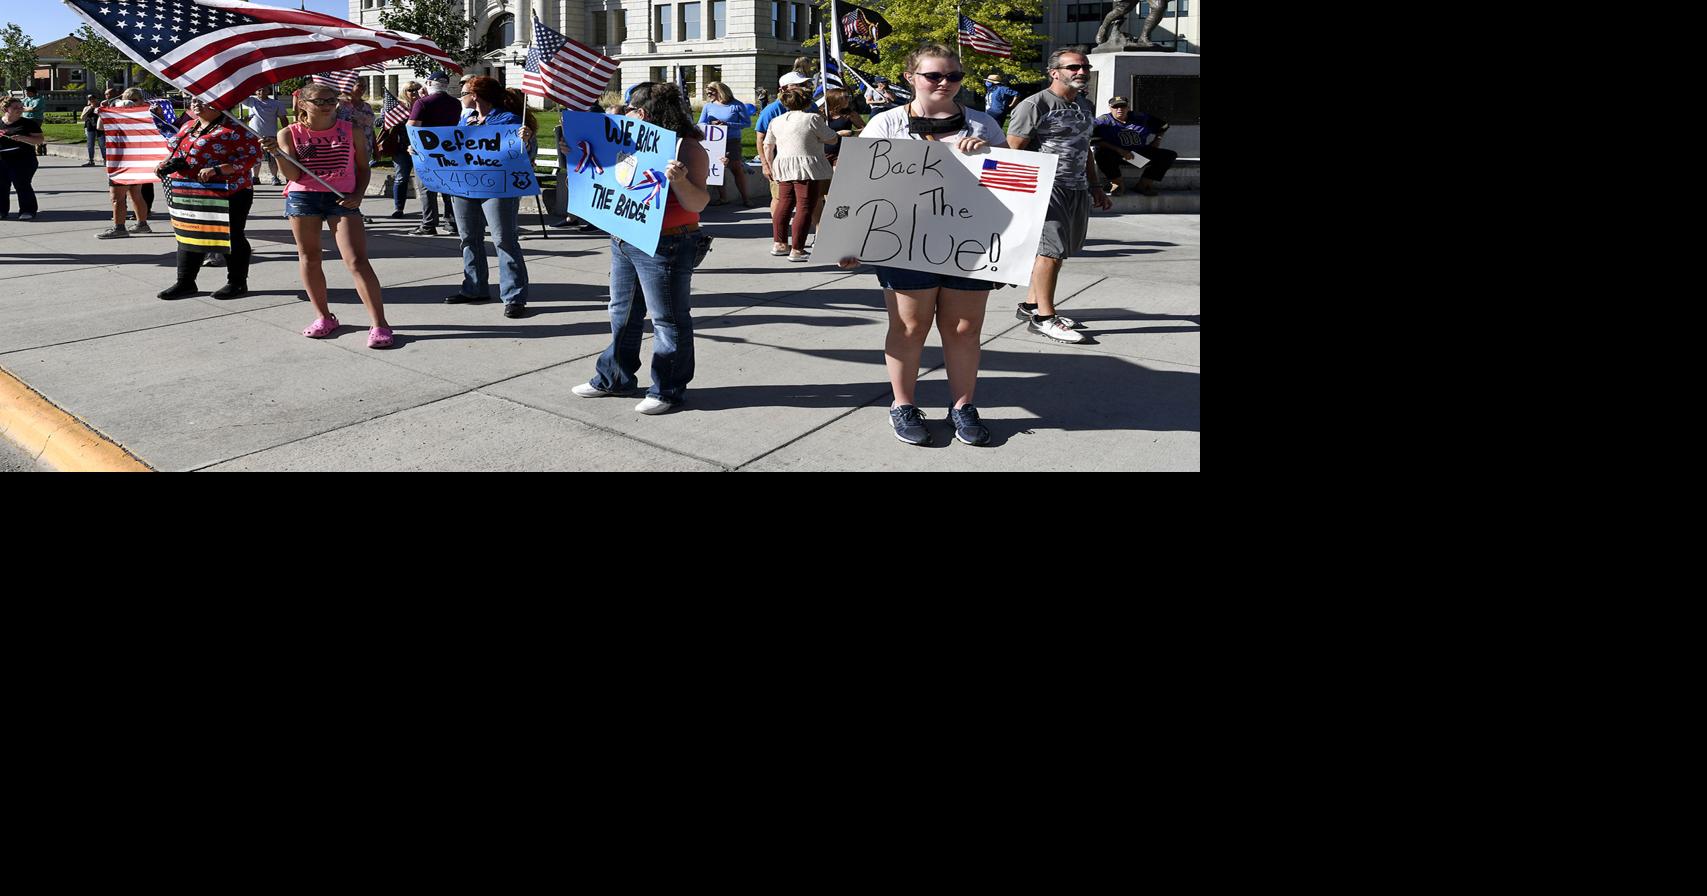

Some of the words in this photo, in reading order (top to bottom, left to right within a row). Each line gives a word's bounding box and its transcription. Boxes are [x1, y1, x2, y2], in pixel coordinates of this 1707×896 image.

[418, 129, 501, 152] Defend
[604, 116, 635, 146] WE
[635, 124, 660, 154] BACK
[428, 153, 459, 168] The
[463, 152, 503, 167] Police
[869, 139, 944, 180] Back
[591, 183, 616, 210] THE
[613, 193, 651, 224] BADGE
[919, 186, 973, 219] The
[855, 198, 1001, 272] Blue!
